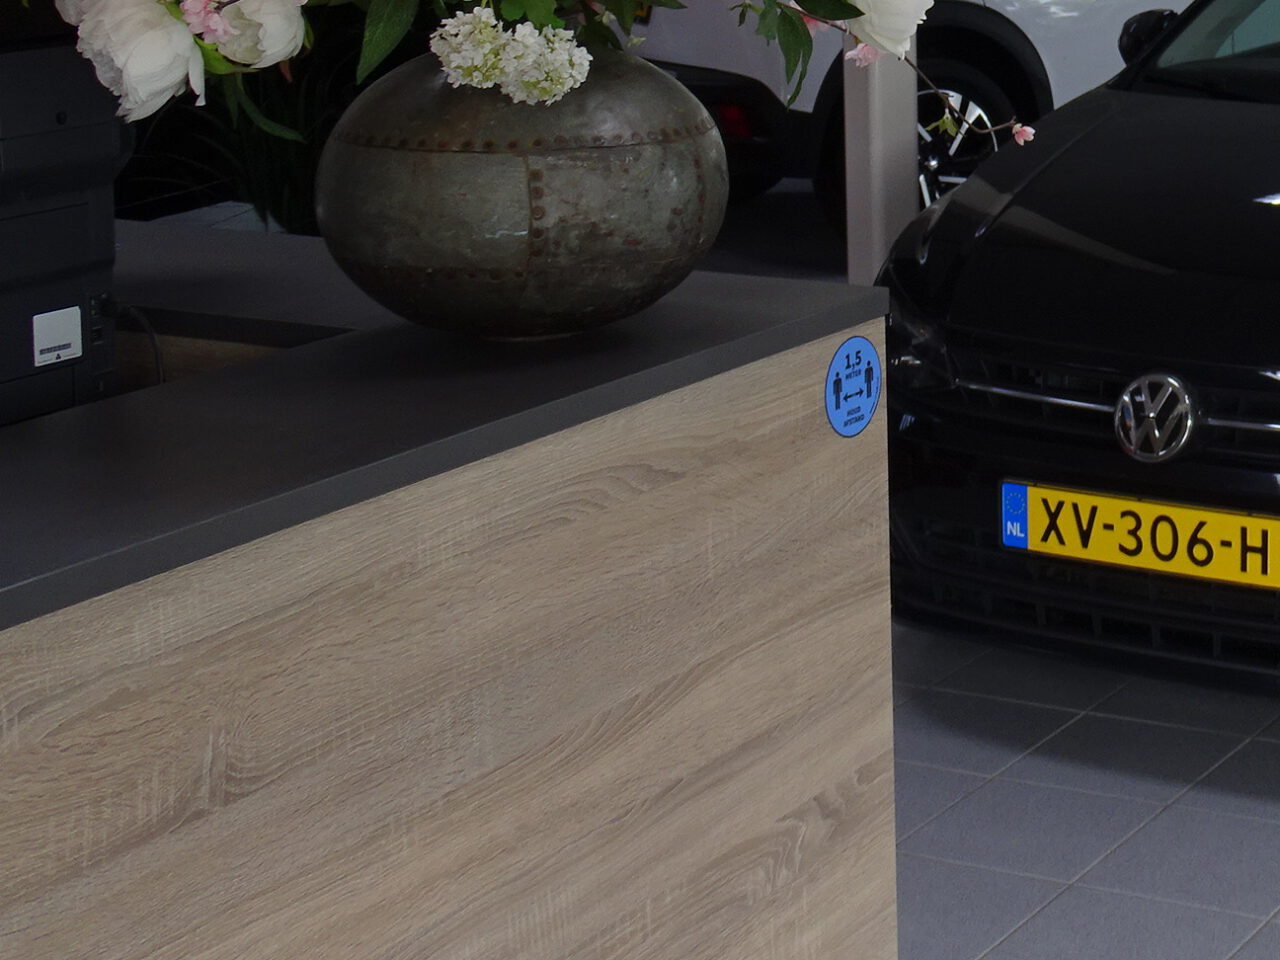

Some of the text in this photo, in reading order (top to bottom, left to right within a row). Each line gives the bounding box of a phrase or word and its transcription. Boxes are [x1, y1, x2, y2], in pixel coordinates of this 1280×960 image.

[845, 350, 862, 370] 1,5
[1006, 520, 1025, 538] NL
[1040, 497, 1269, 576] XV-306-H
